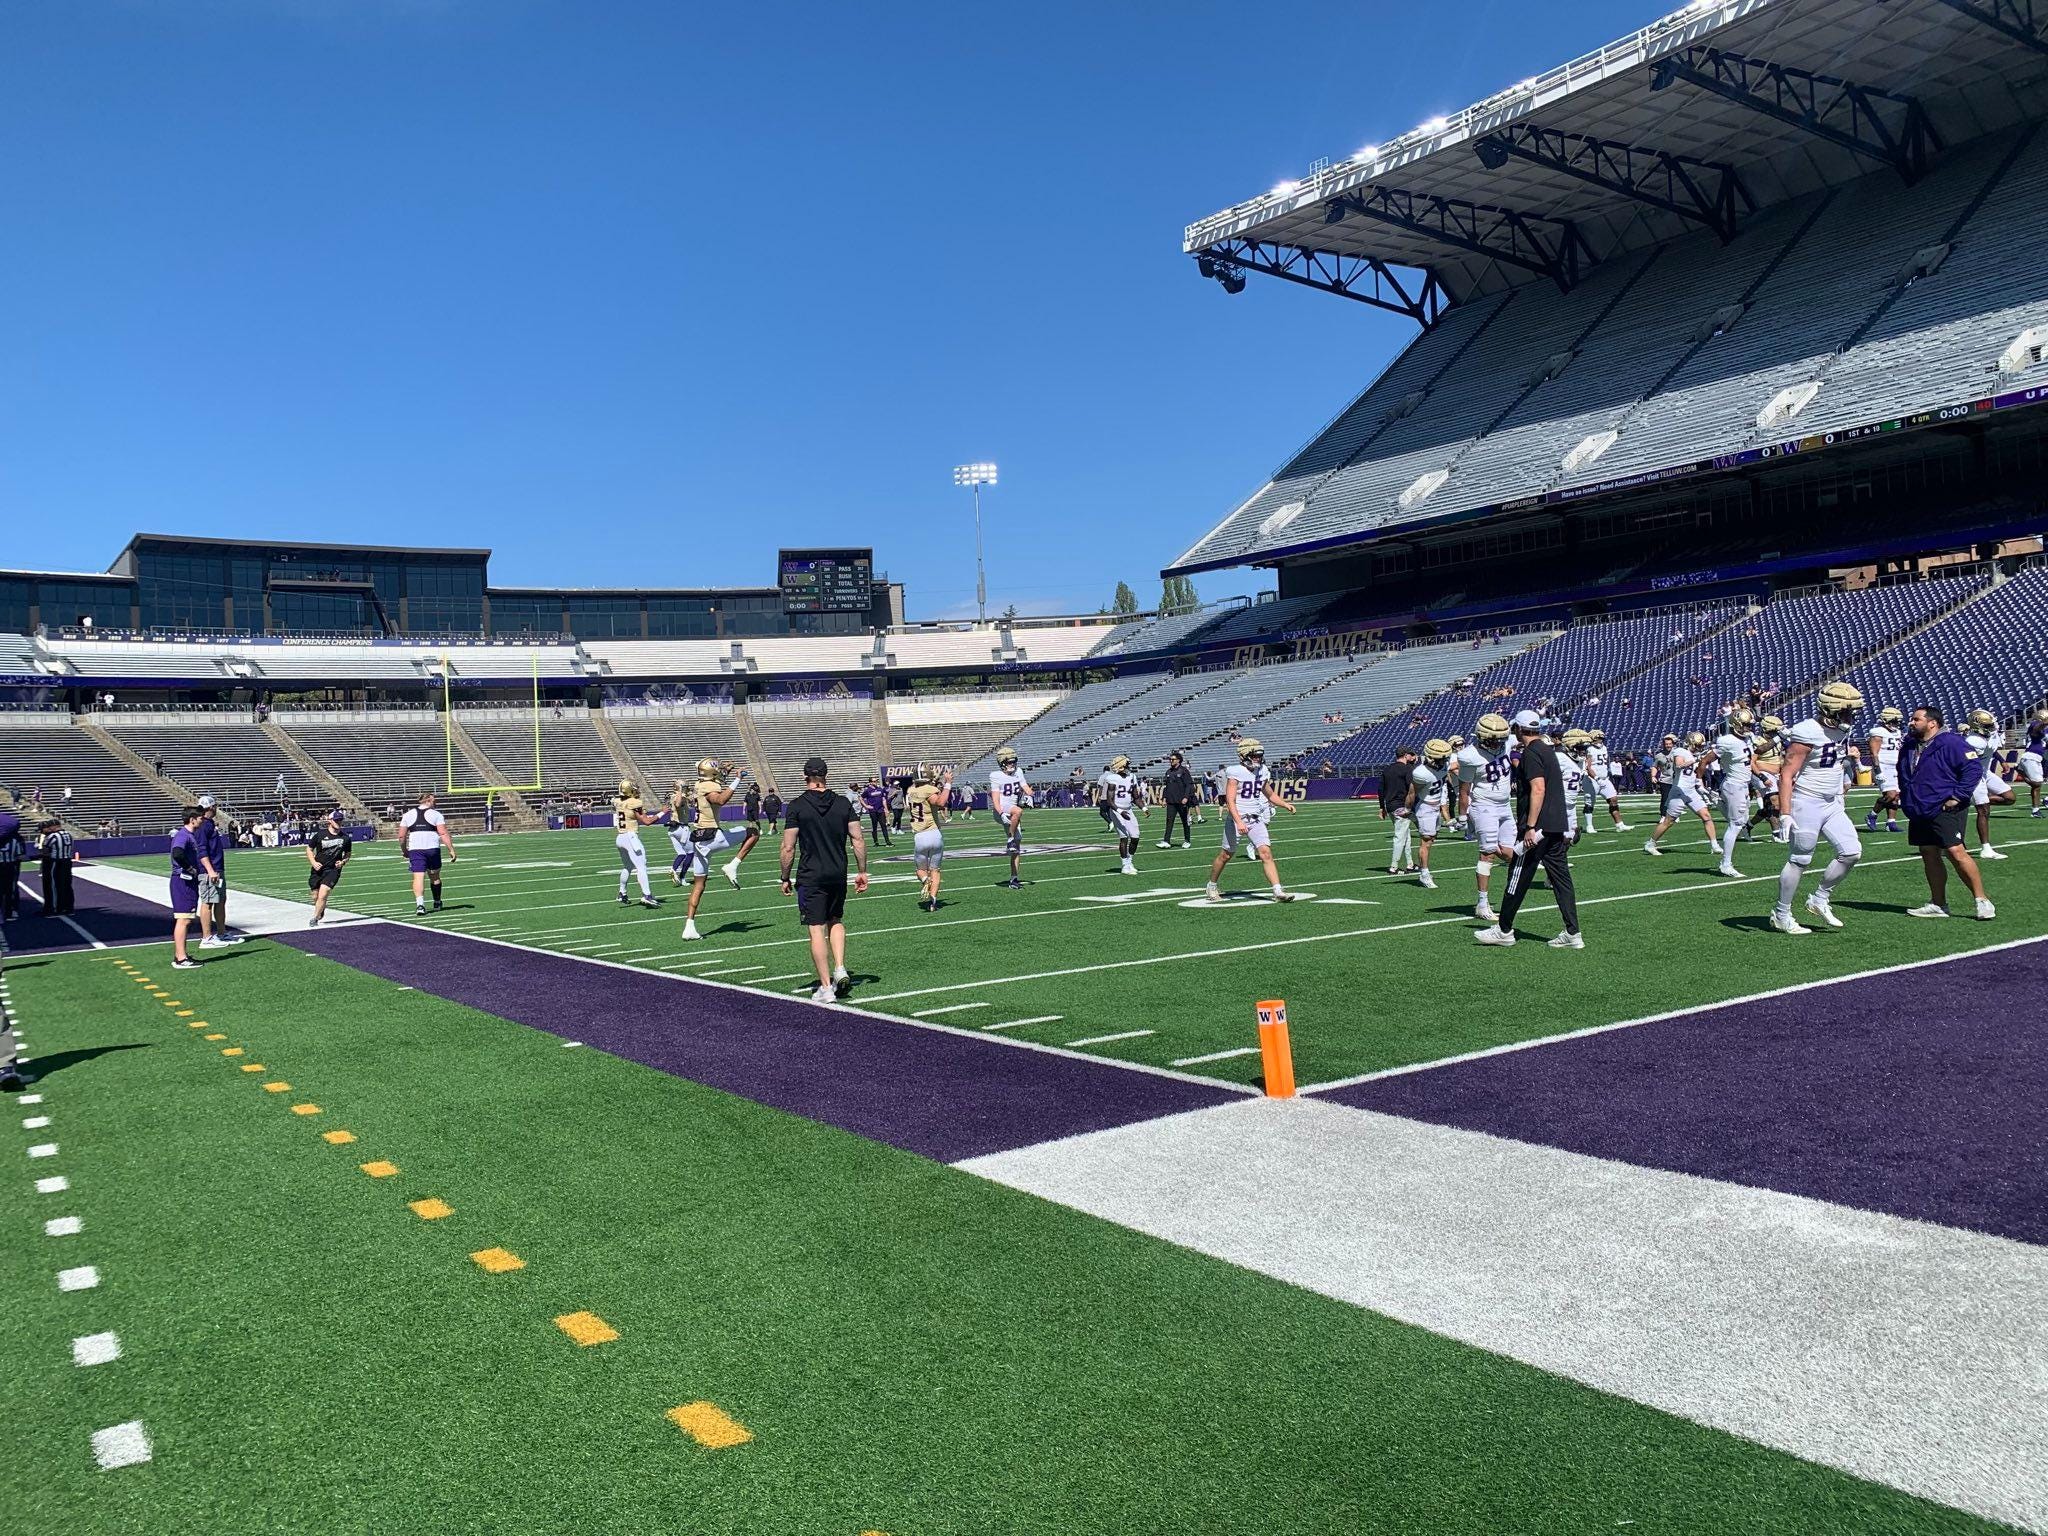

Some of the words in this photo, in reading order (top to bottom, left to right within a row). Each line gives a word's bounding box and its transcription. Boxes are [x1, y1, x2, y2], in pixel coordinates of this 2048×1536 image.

[1939, 406, 1969, 419] 0:00
[1761, 448, 1771, 458] 0
[1825, 434, 1835, 444] 0
[785, 575, 798, 584] W
[282, 638, 331, 646] CONFERENCE
[1294, 629, 1384, 659] DAWGS
[886, 766, 914, 777] BOW
[1003, 782, 1021, 797] 82
[1259, 1011, 1272, 1023] W
[1276, 1009, 1285, 1021] W
